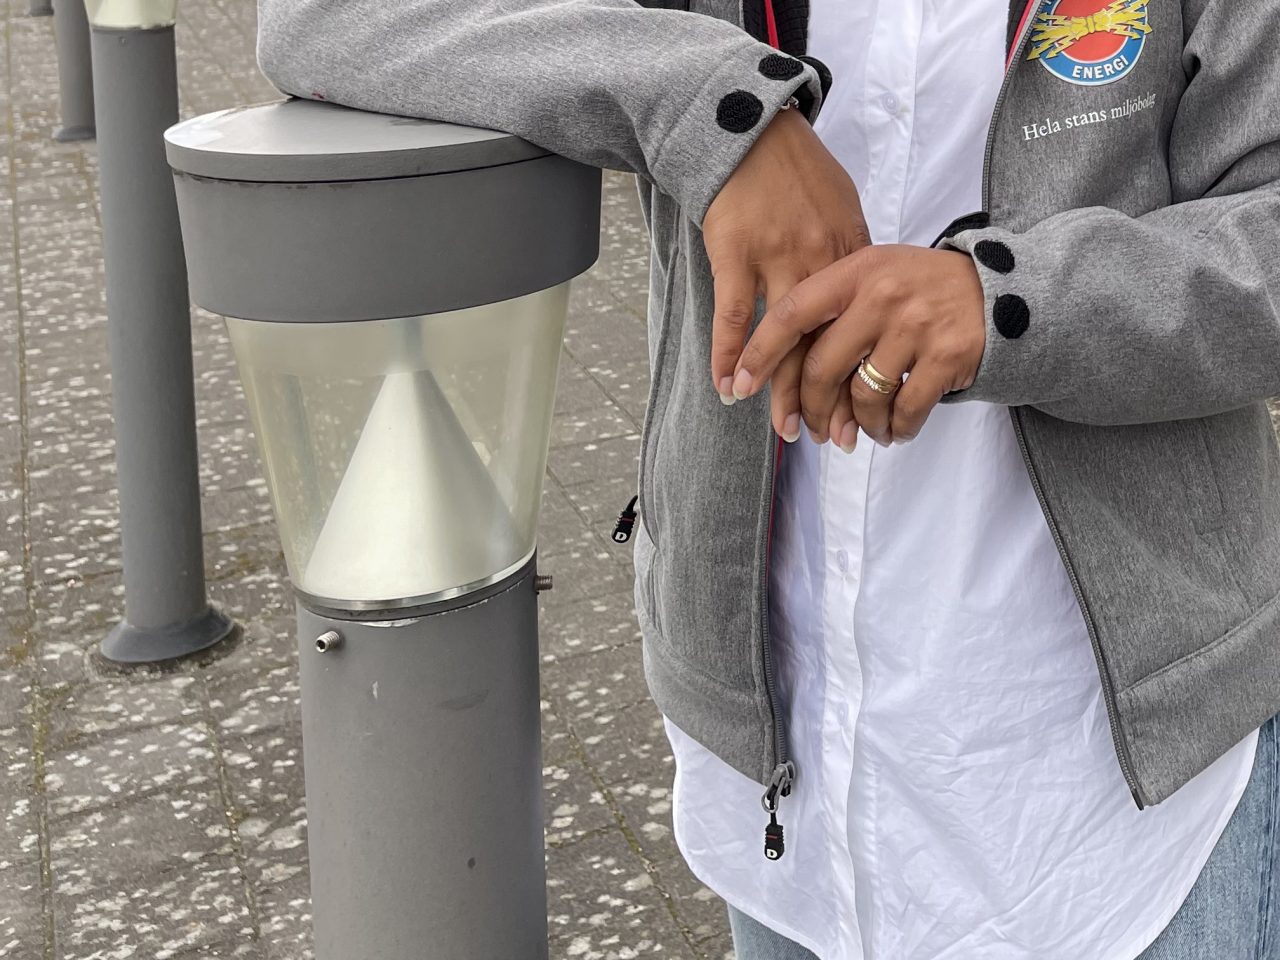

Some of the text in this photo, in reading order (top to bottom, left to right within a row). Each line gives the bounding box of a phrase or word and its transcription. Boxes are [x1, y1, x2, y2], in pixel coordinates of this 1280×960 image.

[1071, 55, 1129, 79] ENERGI
[1022, 118, 1062, 141] Hela
[1065, 108, 1107, 129] stans
